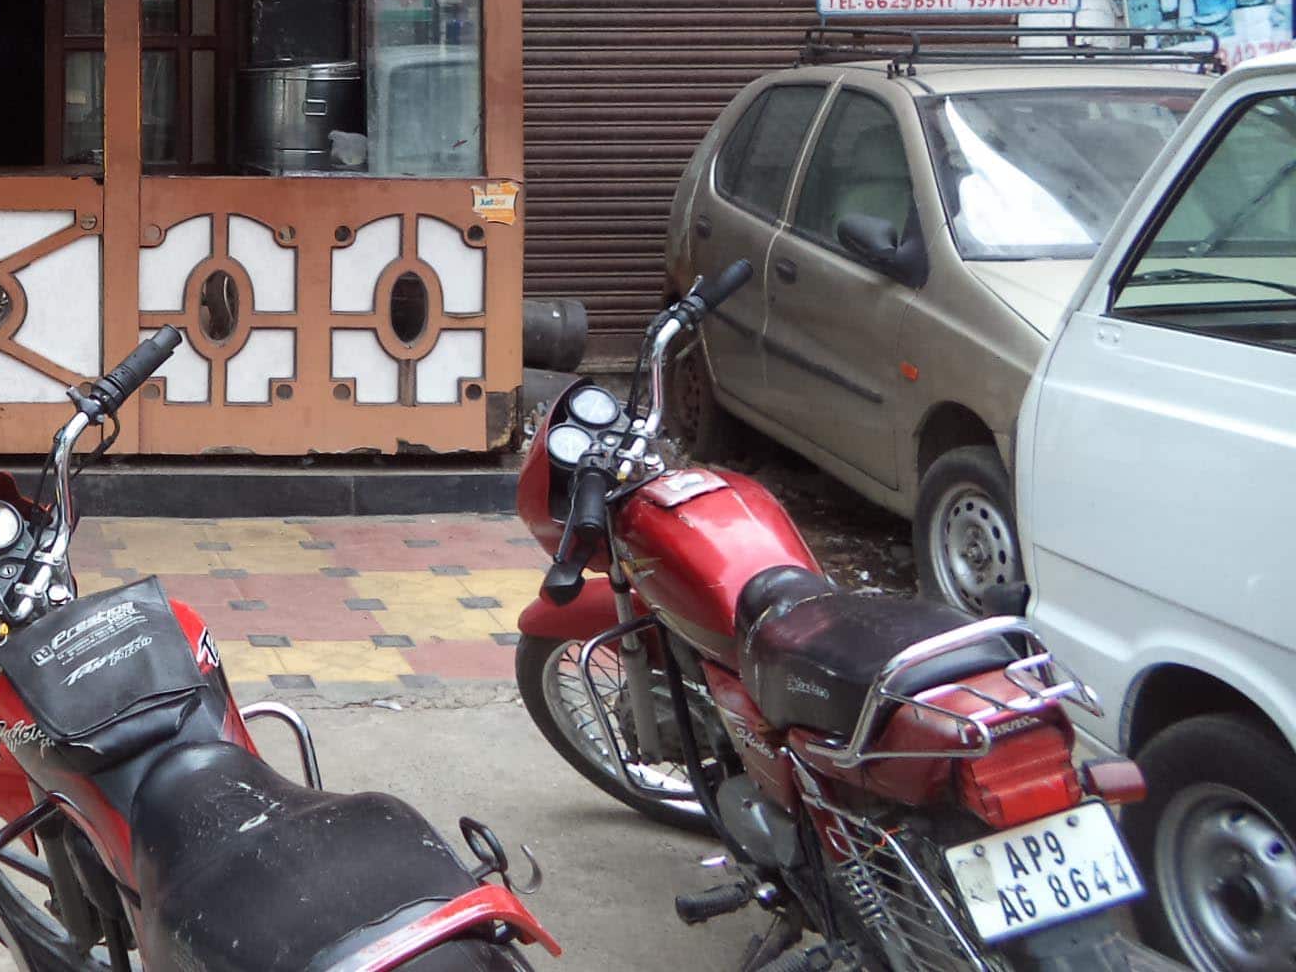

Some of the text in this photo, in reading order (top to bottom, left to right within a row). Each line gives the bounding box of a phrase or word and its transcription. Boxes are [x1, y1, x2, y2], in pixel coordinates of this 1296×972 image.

[1003, 830, 1067, 880] AP9
[997, 849, 1133, 927] AG 8644
